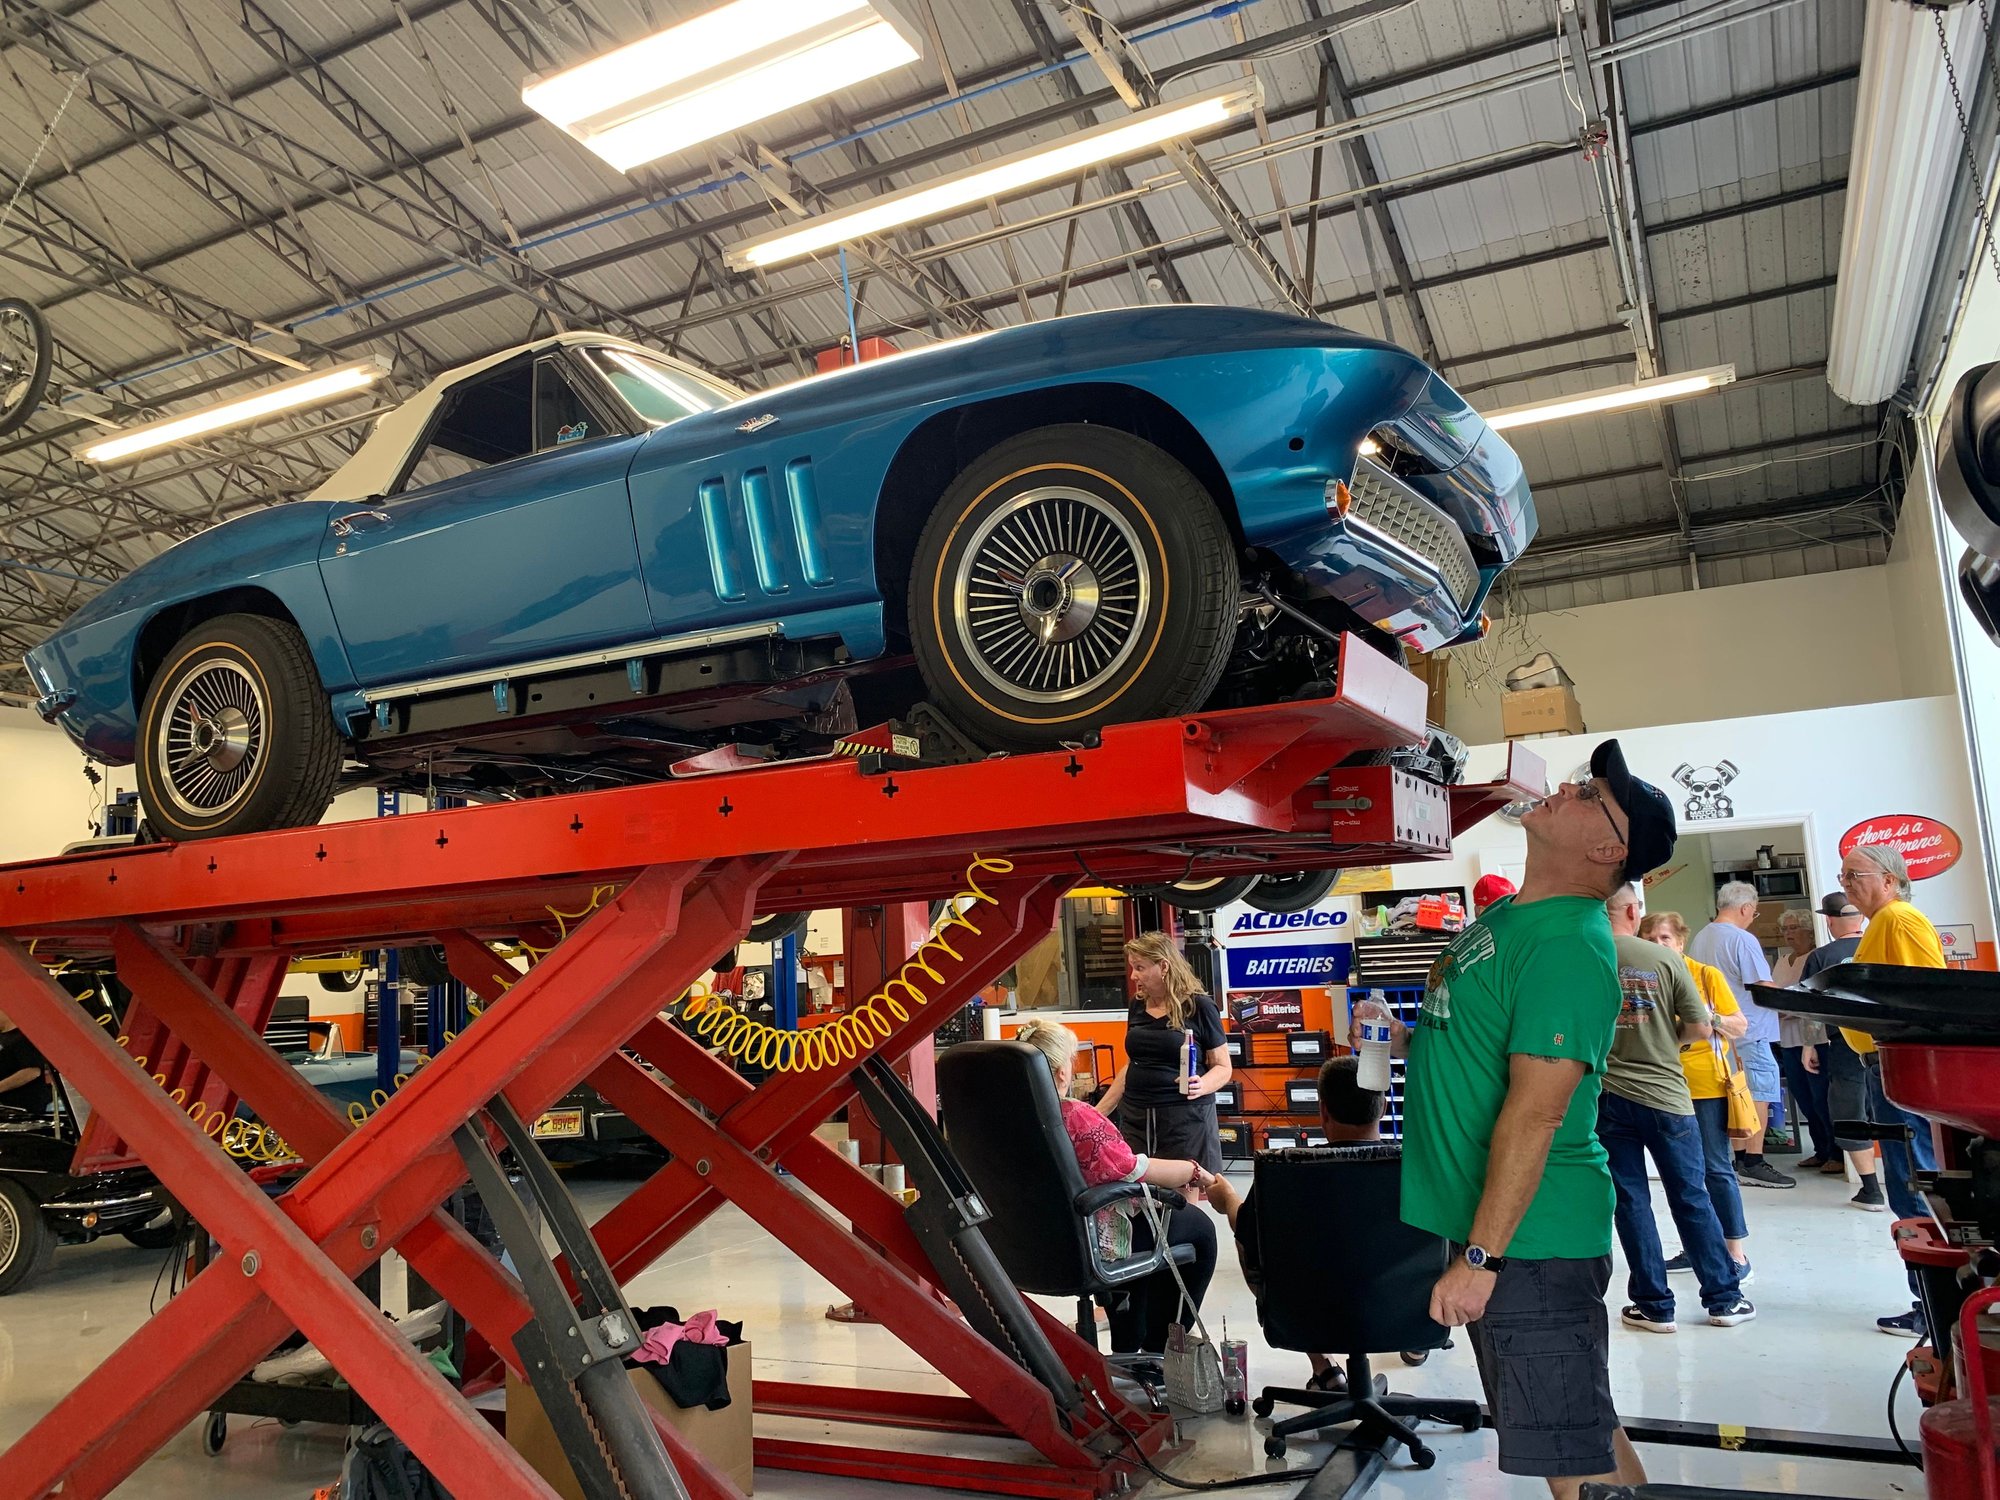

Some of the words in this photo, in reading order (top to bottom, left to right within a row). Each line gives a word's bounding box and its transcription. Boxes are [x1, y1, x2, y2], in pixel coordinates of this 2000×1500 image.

[1893, 823, 1909, 837] is
[1912, 822, 1924, 833] a
[1905, 852, 1952, 866] Snap-on
[1232, 909, 1347, 930] ACDelco
[1245, 957, 1335, 975] BATTERIES
[1263, 1004, 1300, 1015] Batteries
[552, 1118, 577, 1129] 69VET
